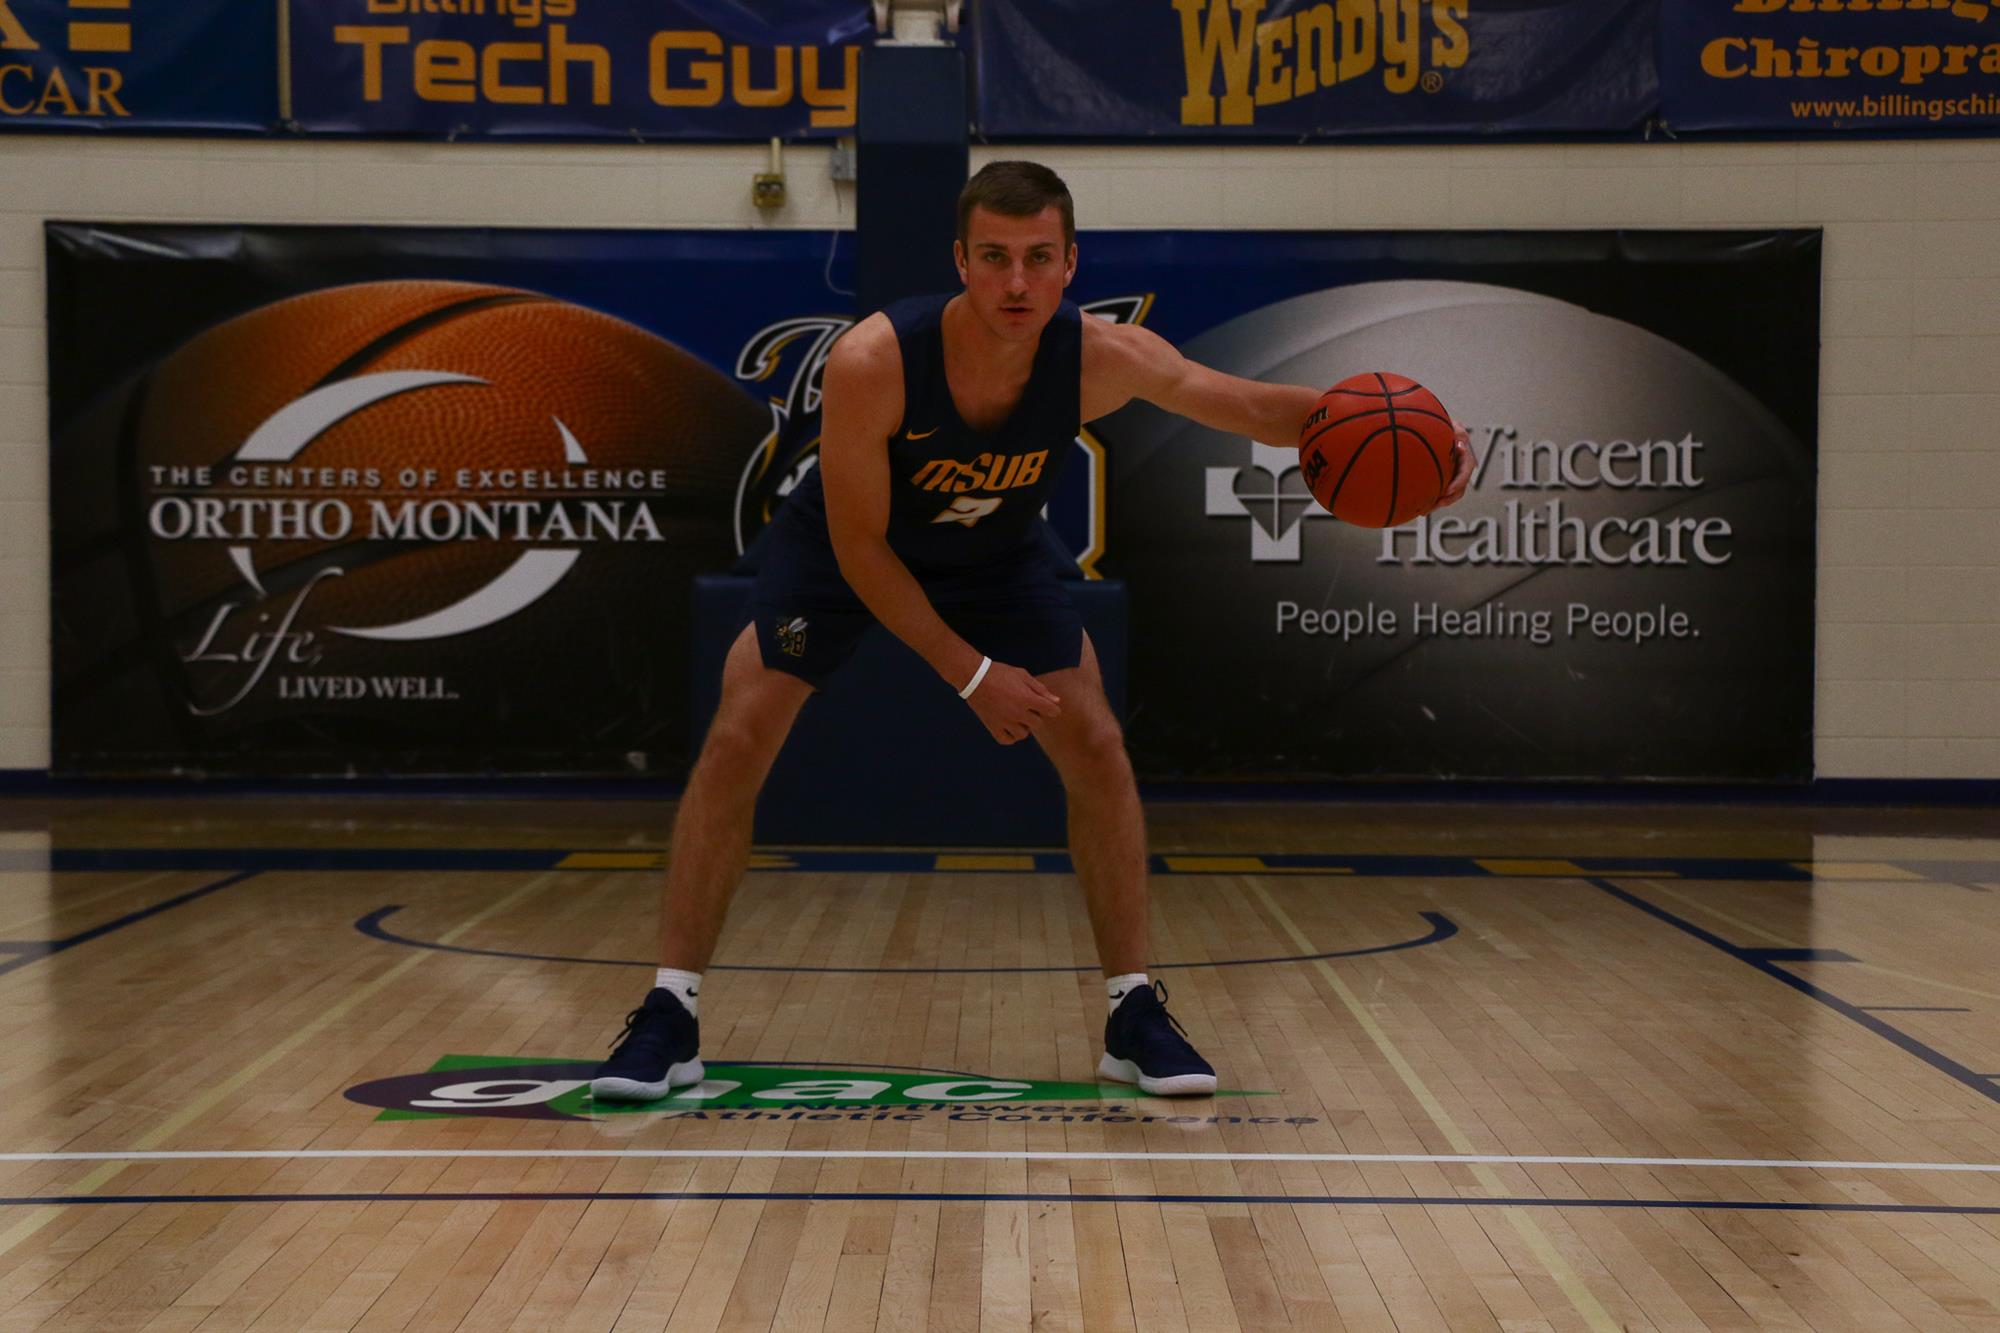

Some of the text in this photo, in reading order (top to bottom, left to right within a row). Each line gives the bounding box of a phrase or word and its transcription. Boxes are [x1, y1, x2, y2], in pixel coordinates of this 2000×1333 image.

[0, 63, 132, 116] CAR
[333, 23, 859, 128] Tech Guy
[150, 465, 667, 490] THE CENTERS OF EXCELLENCE
[911, 448, 1049, 494] MSUB
[148, 498, 666, 542] ORTHO MONTANA
[1376, 498, 1733, 565] Healthcare
[1275, 601, 1701, 645] People Healing People.
[278, 675, 368, 700] LIVED
[661, 1111, 1319, 1125] Athletic Conference
